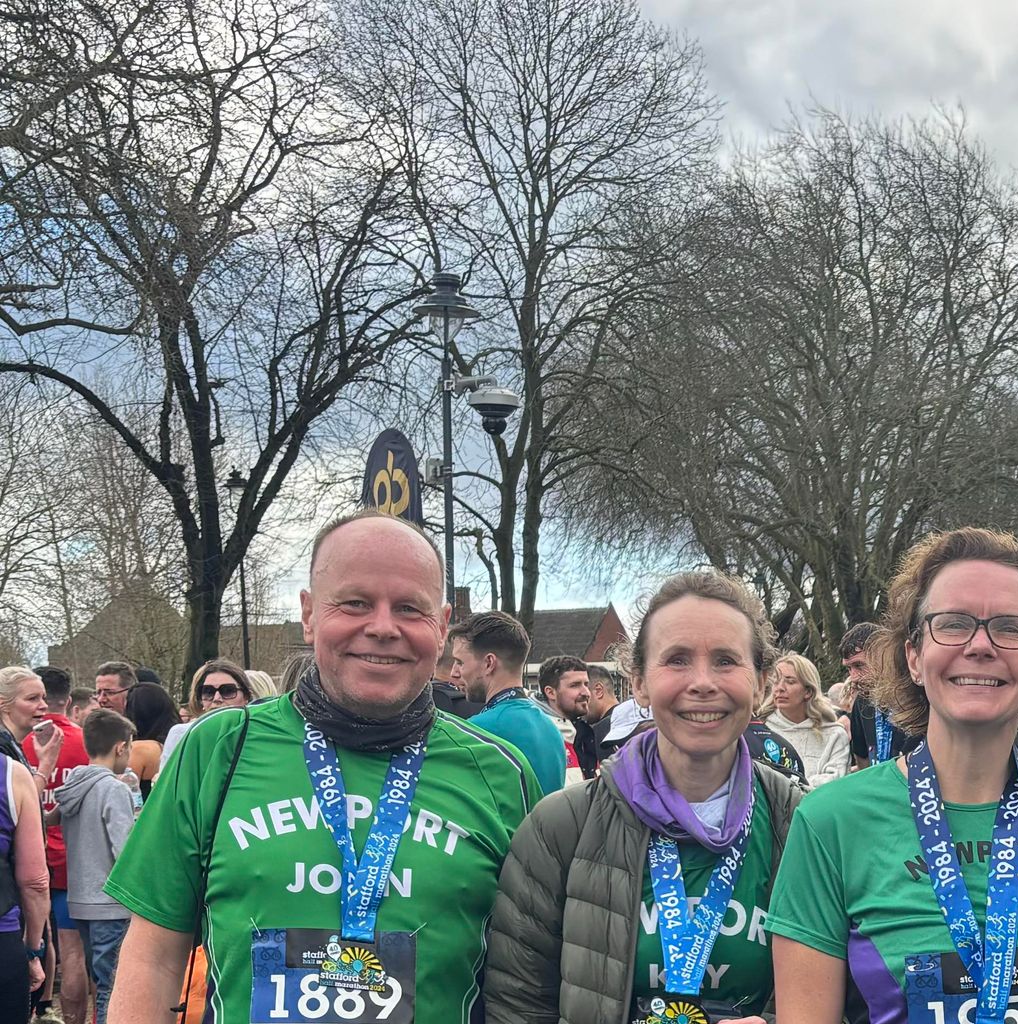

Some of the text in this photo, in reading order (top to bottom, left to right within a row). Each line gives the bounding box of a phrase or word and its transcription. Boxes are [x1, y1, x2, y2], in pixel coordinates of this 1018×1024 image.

[317, 764, 342, 808] 1984
[387, 768, 413, 805] 1984
[915, 777, 941, 826] 2024
[228, 793, 471, 856] NEWPRT
[388, 833, 401, 853] 2024
[286, 862, 412, 898] JON
[718, 846, 742, 886] 1984
[931, 841, 957, 888] 1984
[996, 836, 1016, 880] 1984
[356, 866, 380, 917] stafford
[660, 890, 683, 930] 1984
[1007, 912, 1017, 934] 2024
[320, 972, 360, 982] stafford
[649, 963, 730, 989] KY
[987, 952, 1003, 1010] stafford
[1003, 936, 1015, 988] marathon
[269, 973, 403, 1020] 1889
